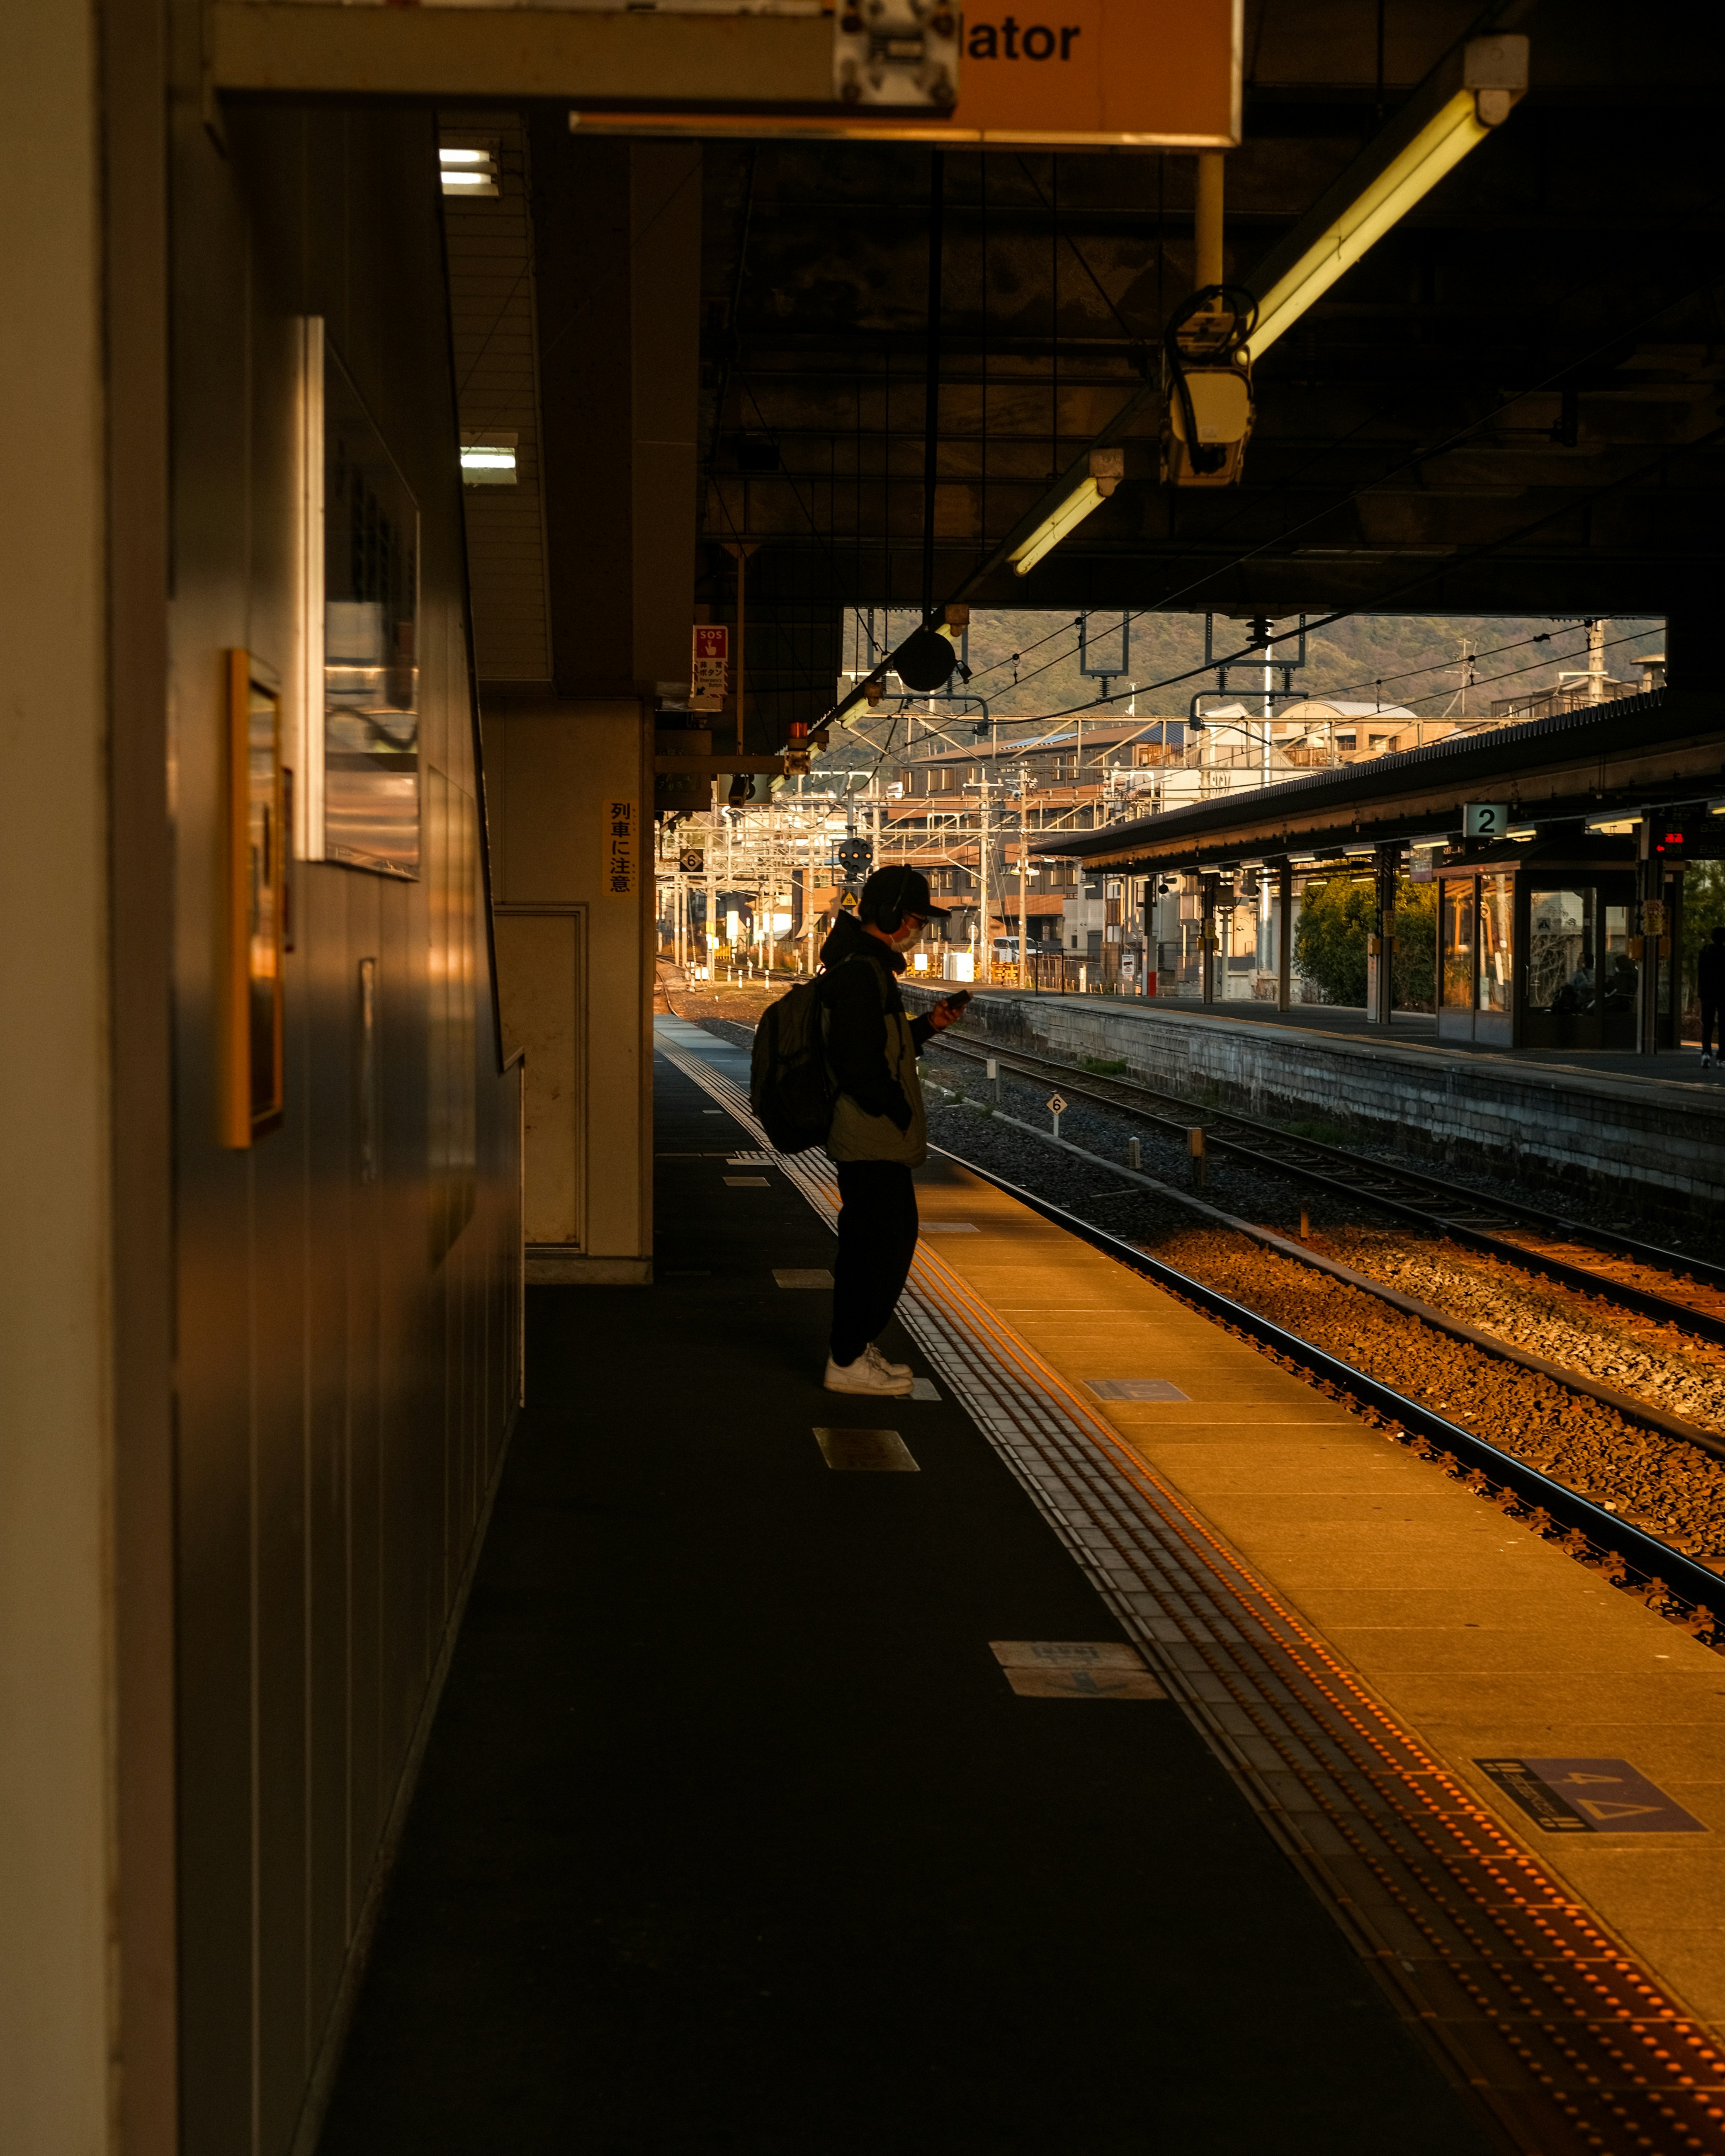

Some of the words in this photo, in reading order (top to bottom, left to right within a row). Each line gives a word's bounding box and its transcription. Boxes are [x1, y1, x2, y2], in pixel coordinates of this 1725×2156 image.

[1479, 809, 1494, 833] 2
[610, 803, 630, 892] 列車に注意
[688, 855, 696, 867] 6
[1053, 1099, 1061, 1111] 6
[1562, 1772, 1624, 1784] 4
